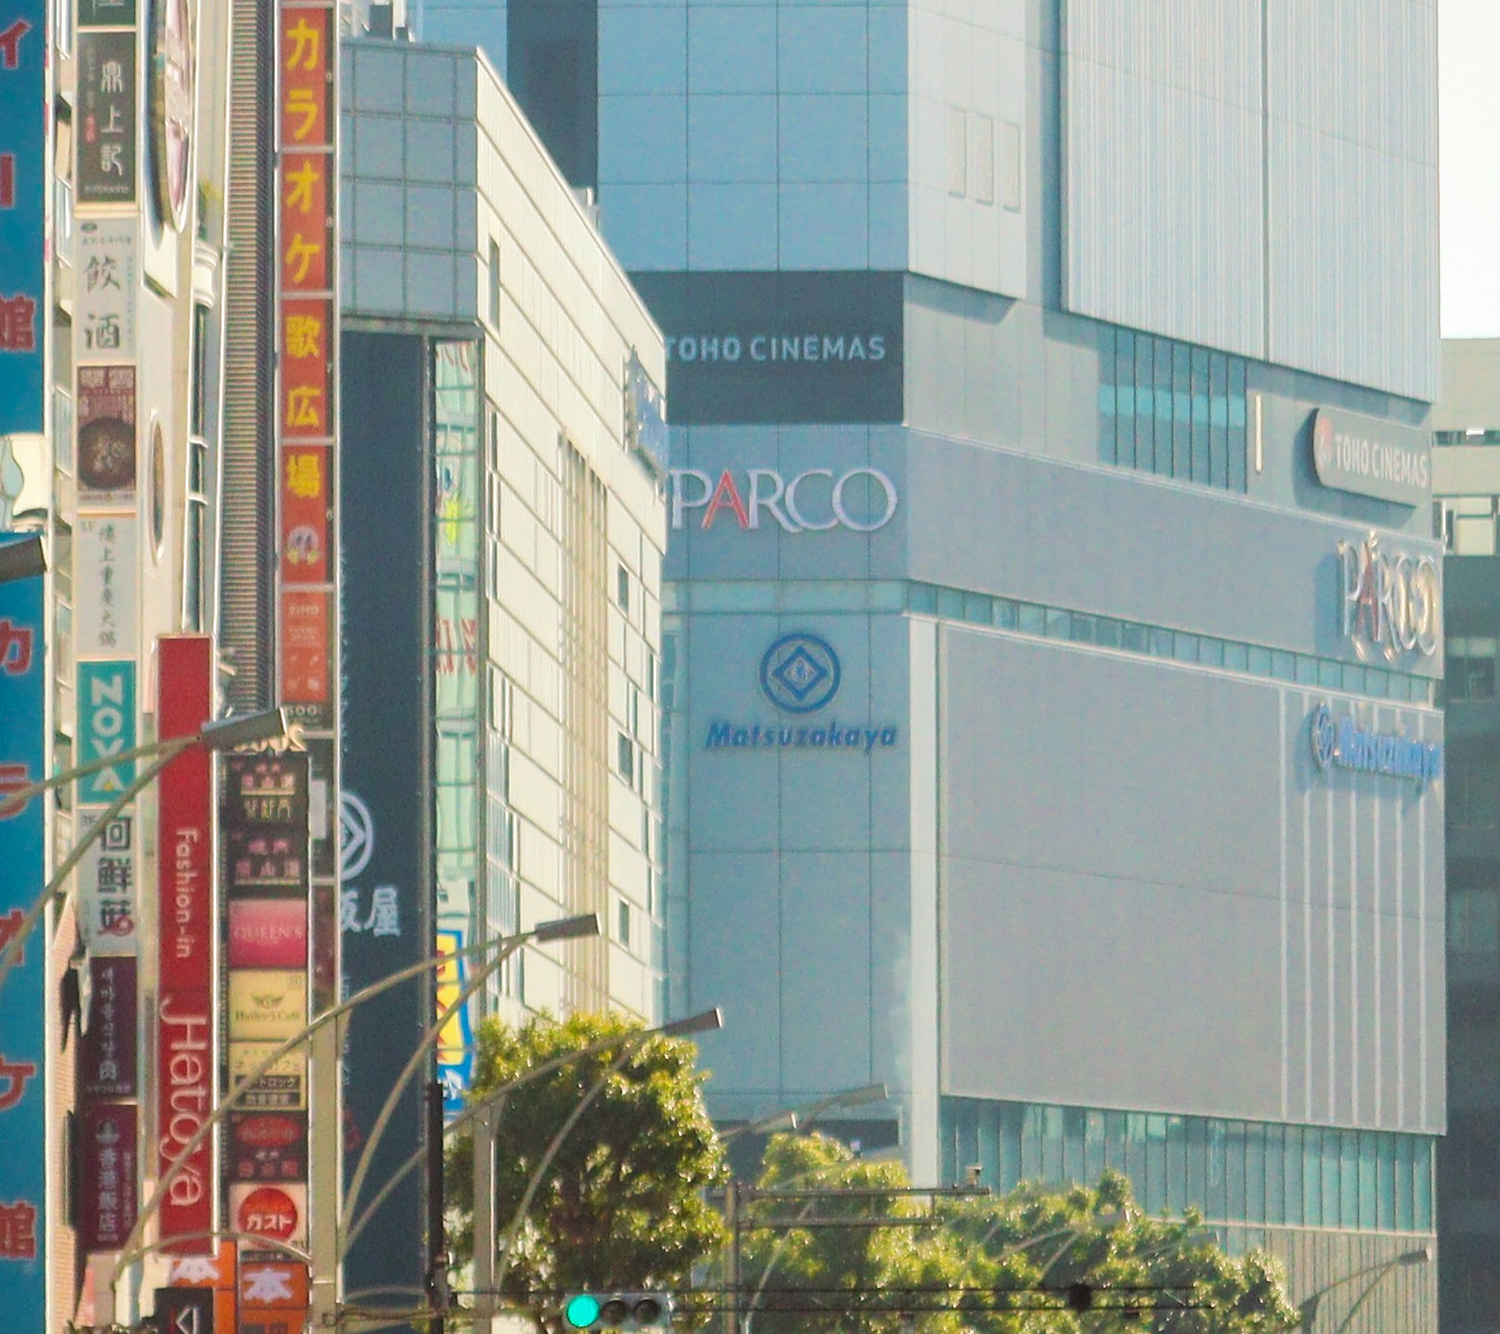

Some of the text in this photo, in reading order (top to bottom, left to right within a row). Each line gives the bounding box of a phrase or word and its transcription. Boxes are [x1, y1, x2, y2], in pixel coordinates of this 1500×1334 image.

[284, 19, 326, 501] カラオケ歌広場
[666, 337, 885, 361] TOHO CINEMAS
[669, 468, 898, 533] PARCO
[1334, 433, 1429, 489] TOHO CINEMAS
[1338, 535, 1440, 657] PARCO
[90, 675, 124, 793] NOVA
[705, 722, 898, 754] Matsuzakaya
[174, 825, 201, 960] Fashion-in
[160, 996, 208, 1208] Hatoya
[245, 1212, 293, 1231] ガスト
